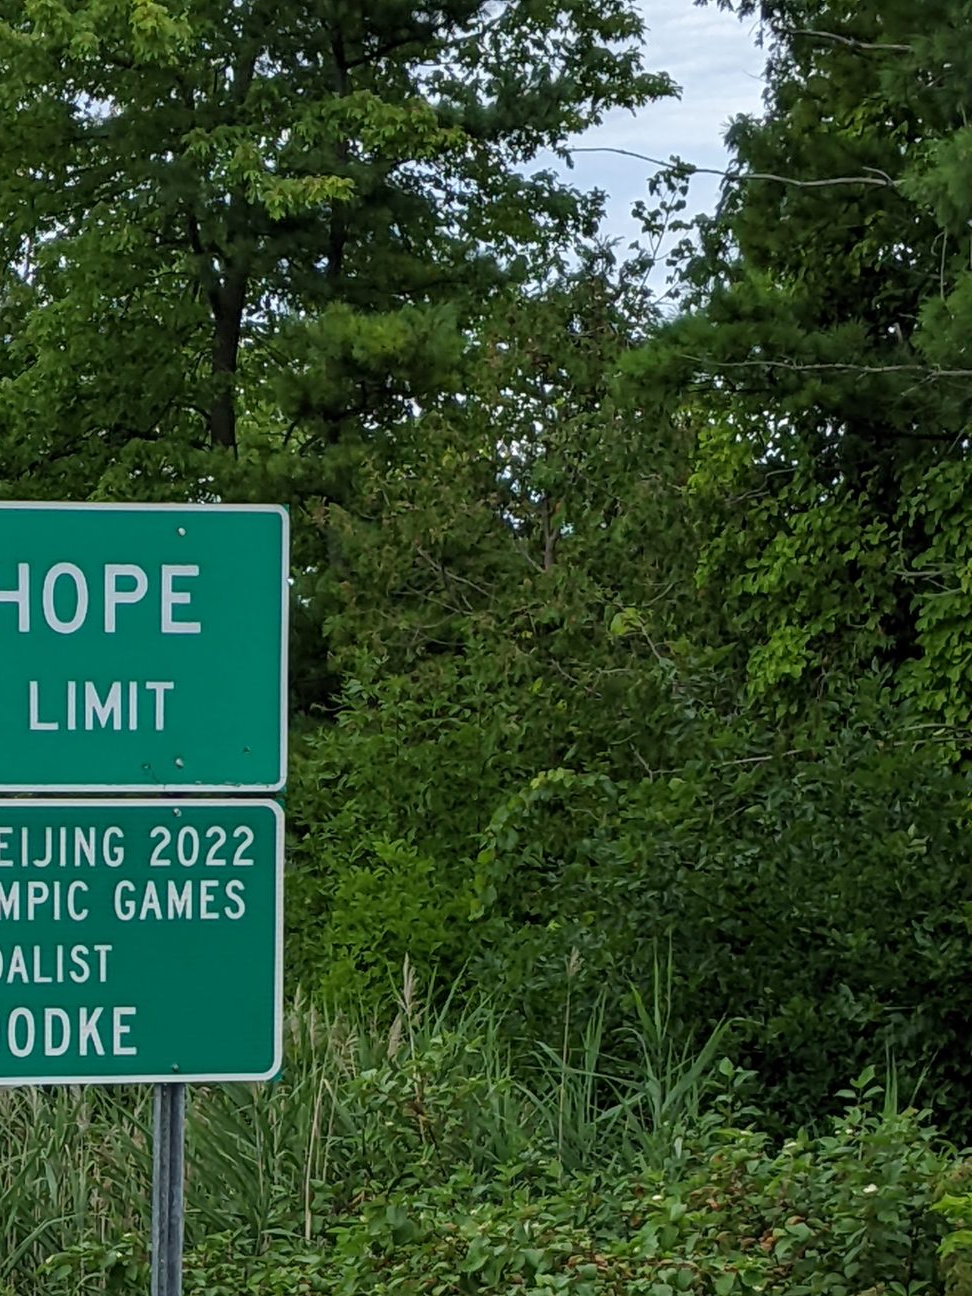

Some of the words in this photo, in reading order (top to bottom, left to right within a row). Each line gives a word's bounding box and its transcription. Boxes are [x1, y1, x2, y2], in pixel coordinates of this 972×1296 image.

[29, 681, 174, 731] LIMIT
[150, 825, 255, 867] 2022
[114, 879, 246, 921] GAMES
